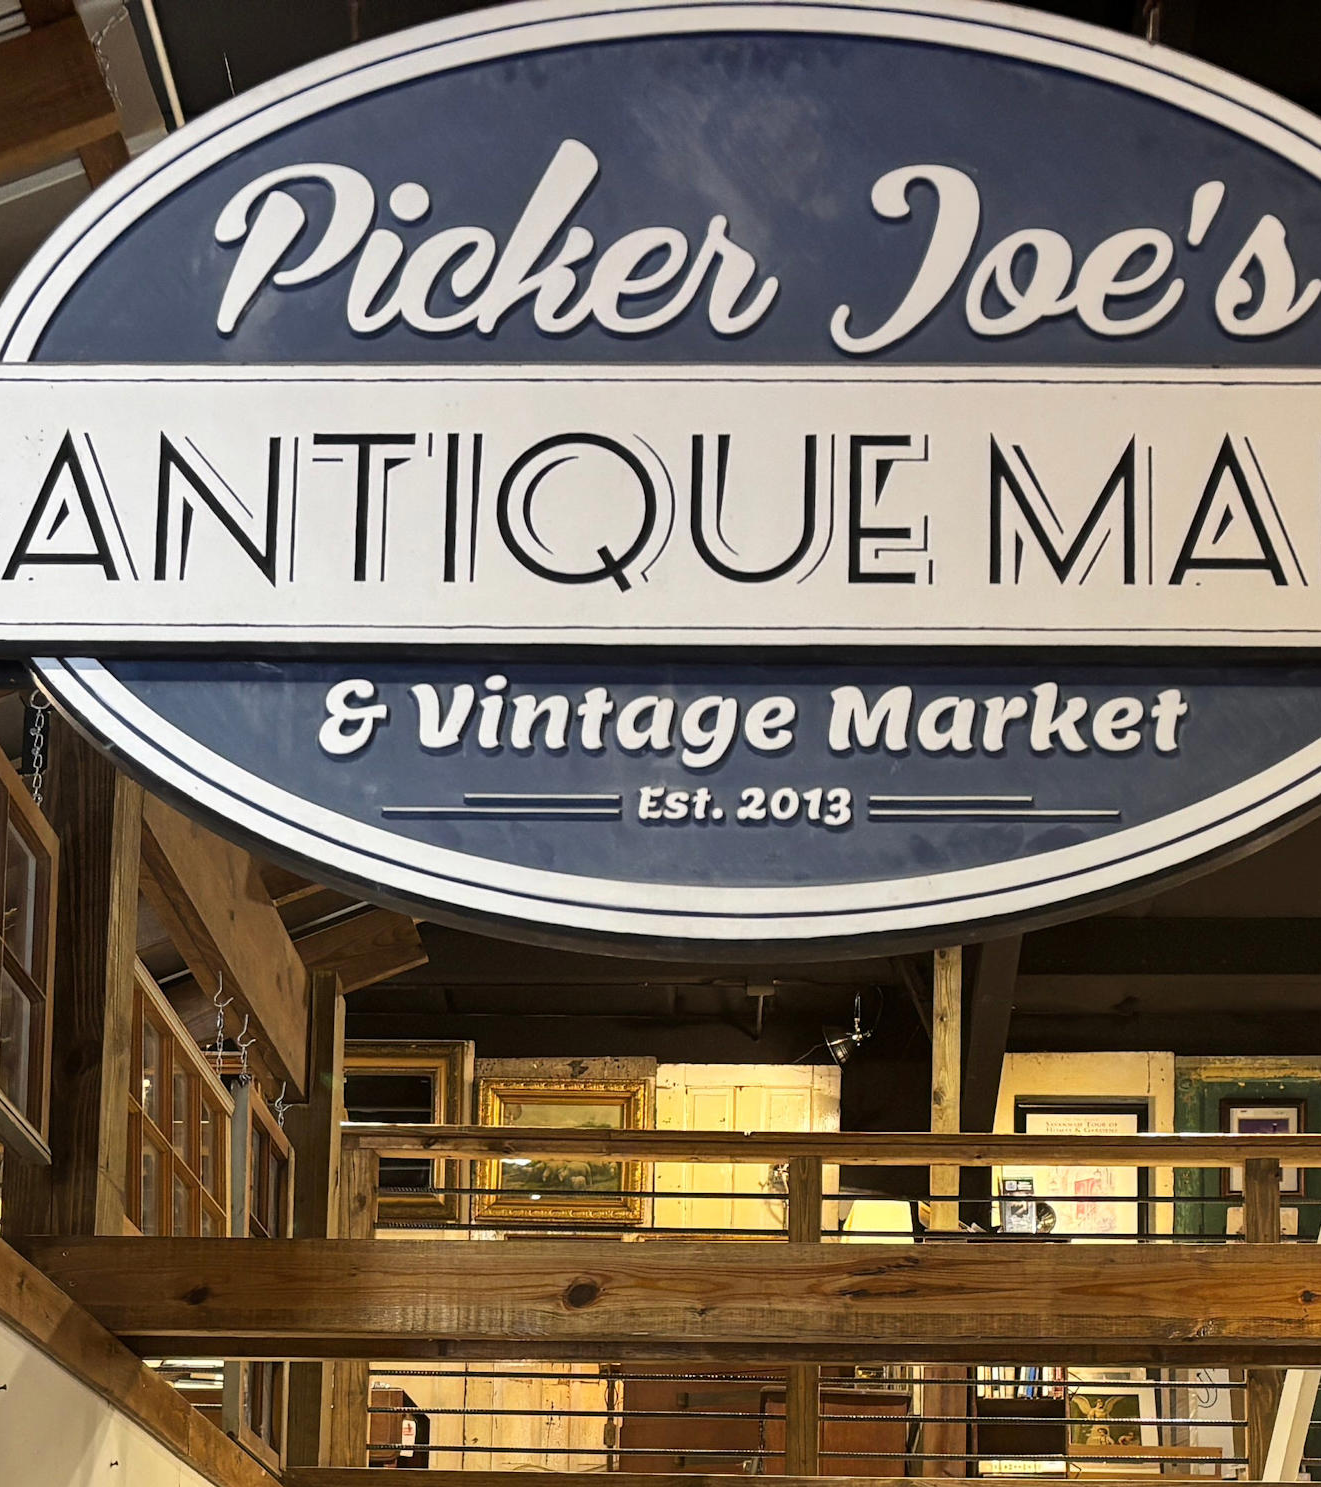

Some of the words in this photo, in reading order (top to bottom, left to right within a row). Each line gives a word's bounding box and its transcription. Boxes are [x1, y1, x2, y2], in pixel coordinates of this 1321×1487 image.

[214, 138, 779, 337] Picker
[1, 428, 934, 592] ANTIQUE
[319, 678, 388, 755] &
[412, 674, 796, 768] Vintage
[828, 681, 1188, 752] Market
[638, 786, 725, 821] Est.
[738, 787, 853, 826] 2013
